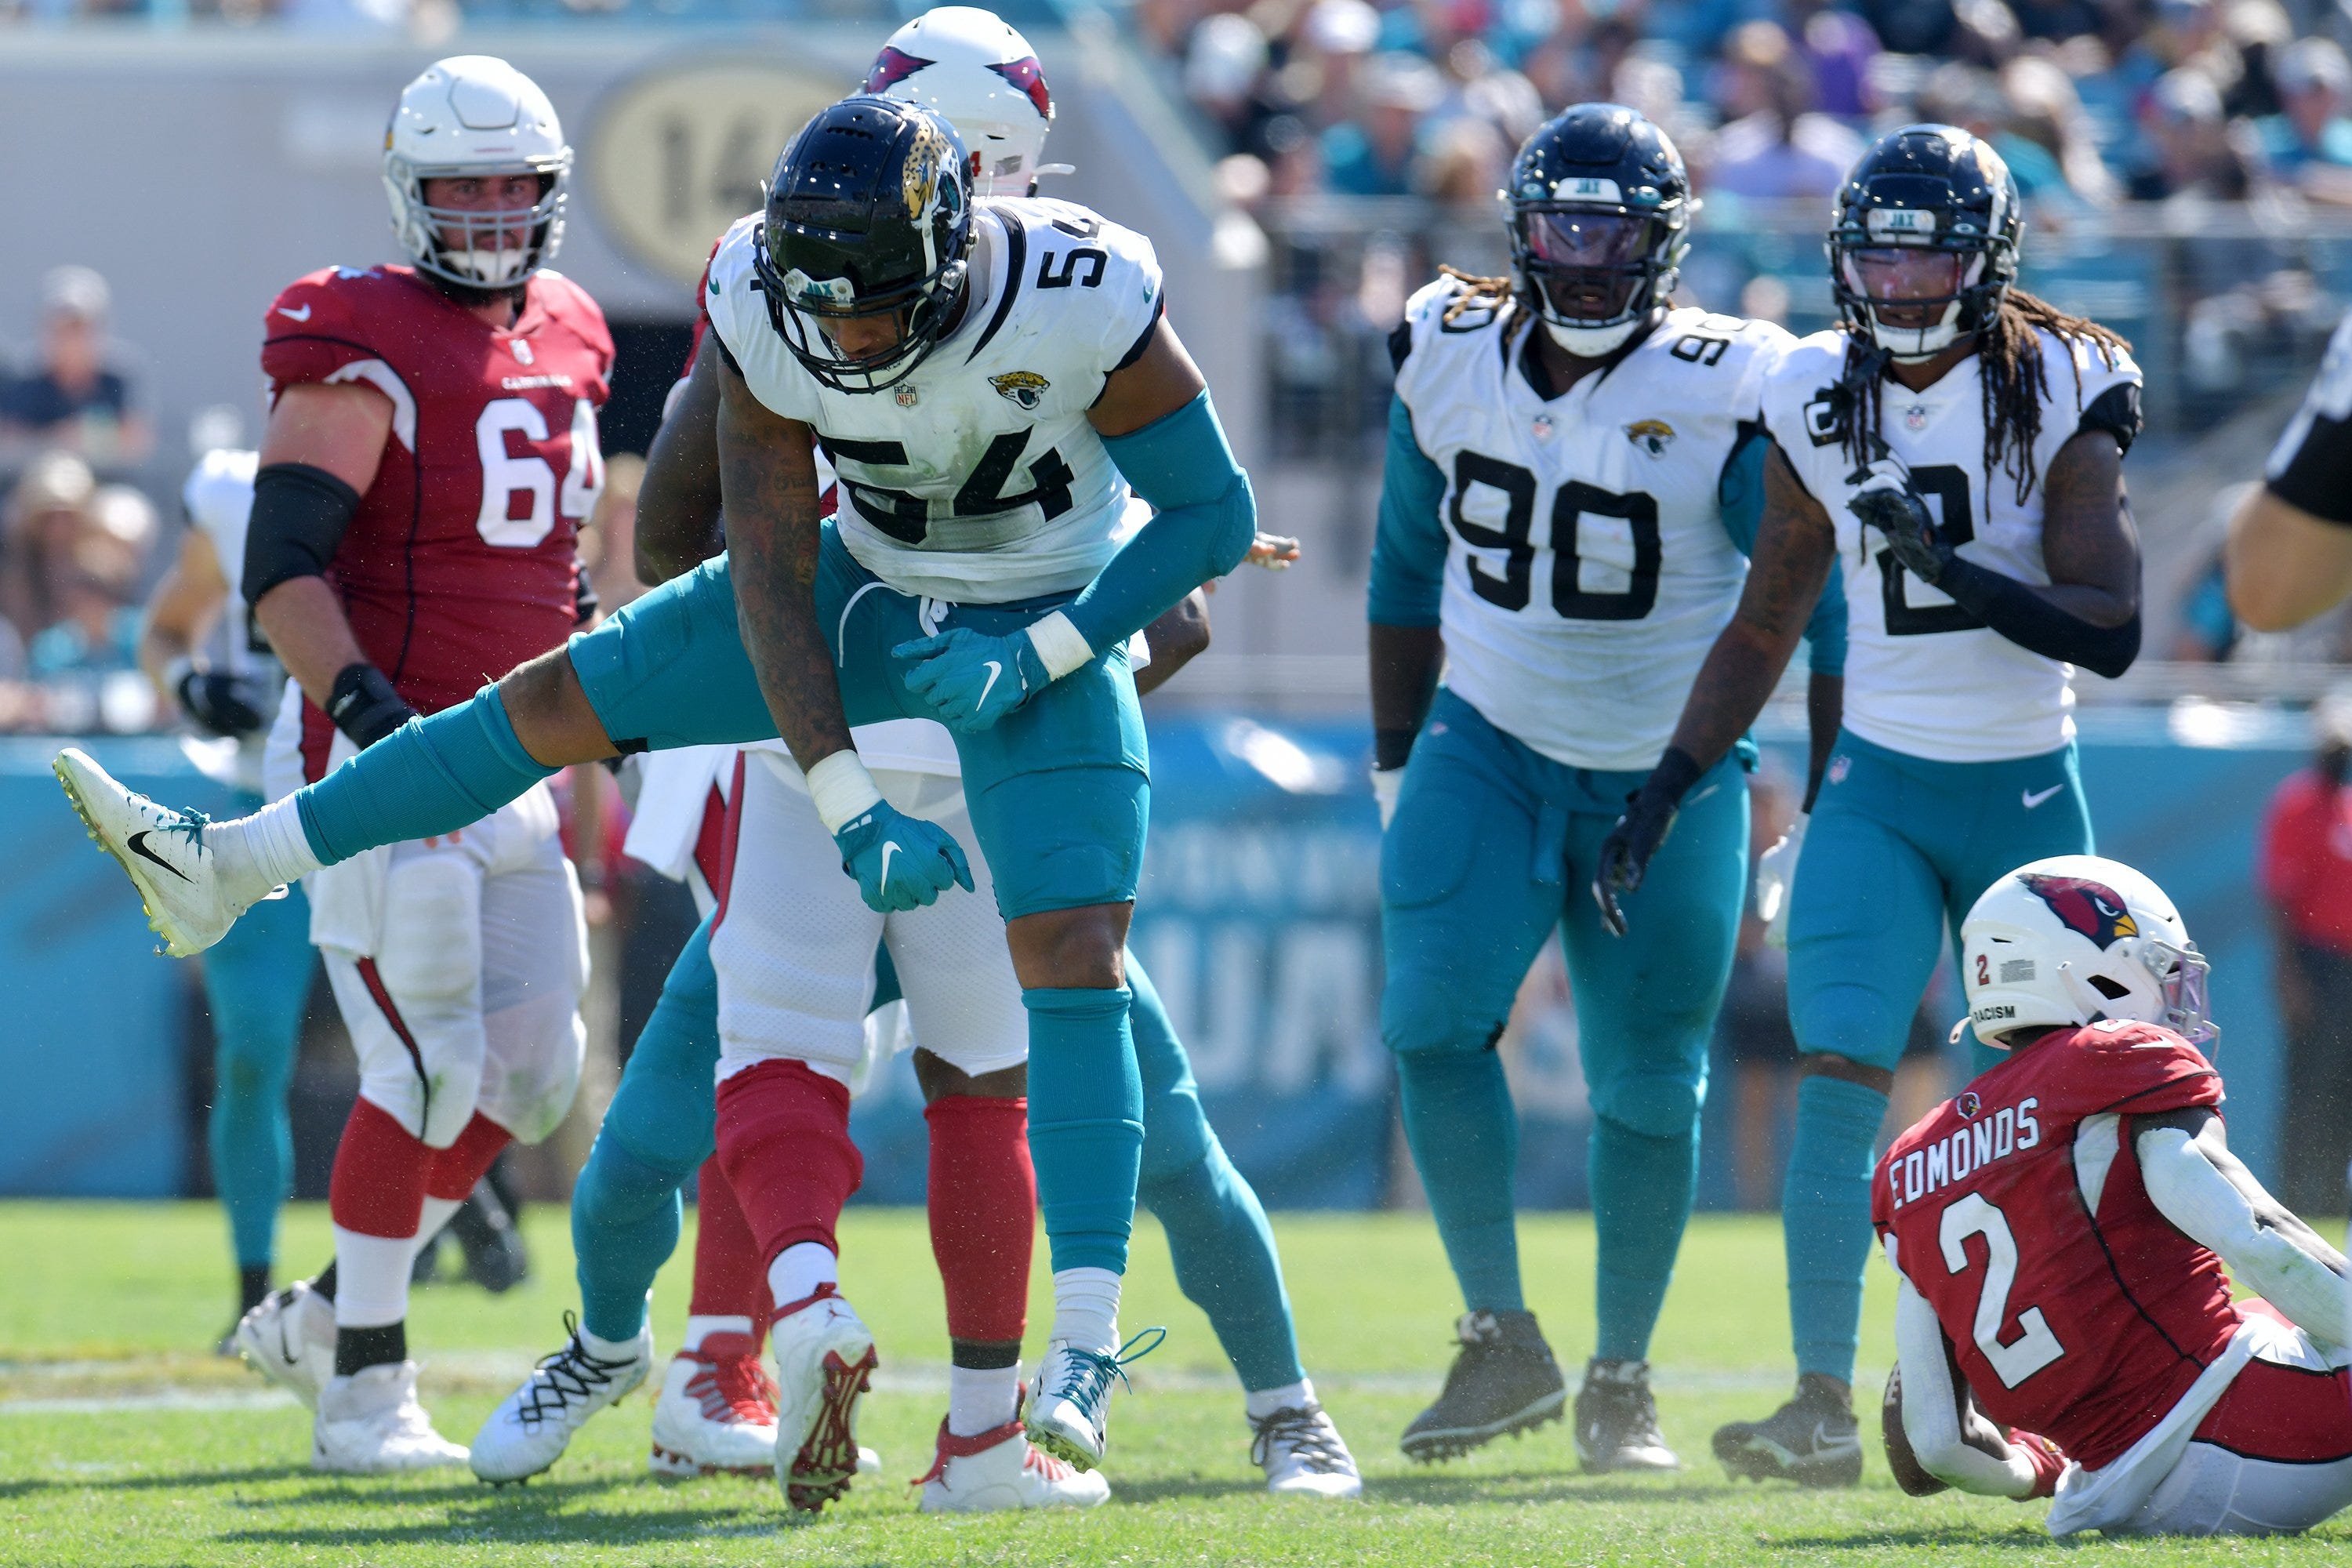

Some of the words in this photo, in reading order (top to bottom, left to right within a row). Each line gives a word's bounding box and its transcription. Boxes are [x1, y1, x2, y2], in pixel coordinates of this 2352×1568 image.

[898, 394, 916, 405] NFL
[476, 397, 607, 548] 64
[809, 423, 1075, 545] 54
[1449, 449, 1662, 620] 90
[1876, 464, 1990, 636] 2
[1976, 953, 1990, 986] 2
[1889, 1098, 2040, 1210] EDMONDS
[1938, 1191, 2065, 1390] 2
